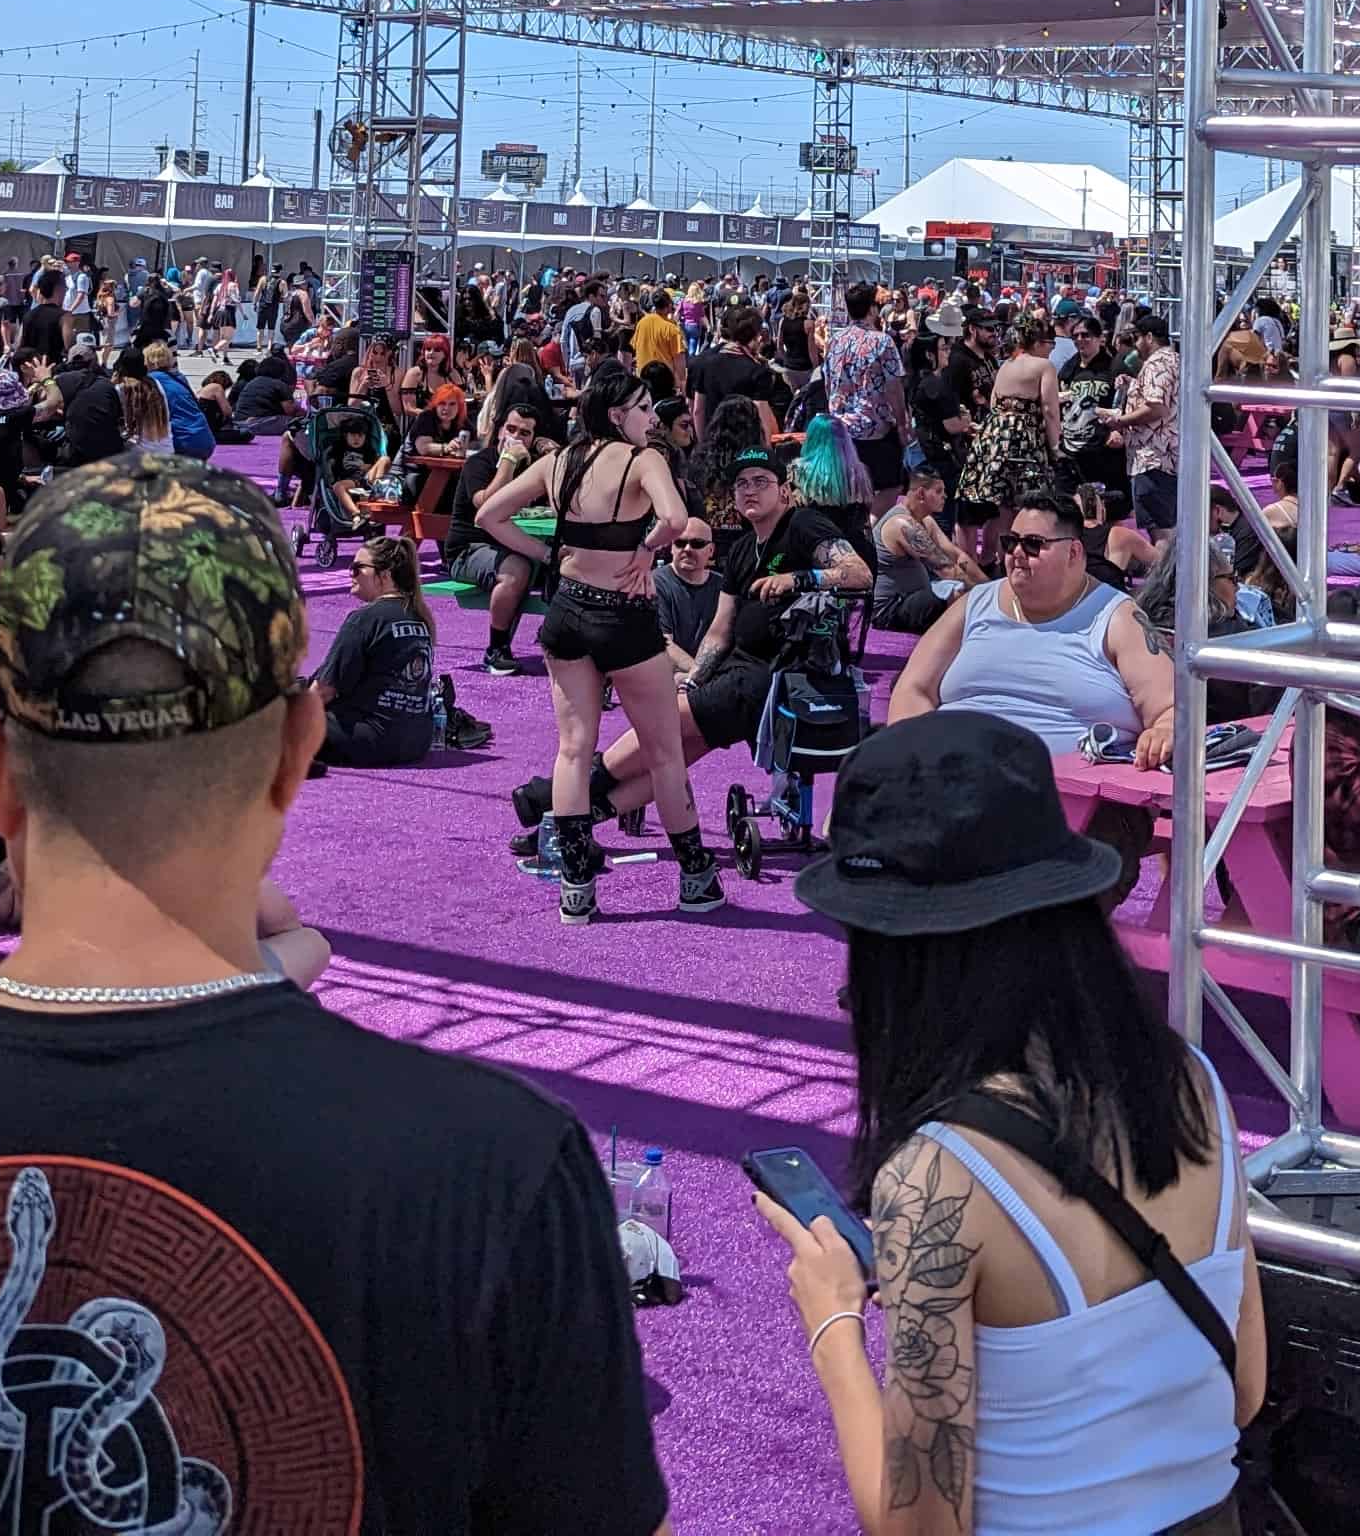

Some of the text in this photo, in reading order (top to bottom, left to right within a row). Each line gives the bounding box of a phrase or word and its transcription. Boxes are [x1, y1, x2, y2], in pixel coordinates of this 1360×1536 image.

[214, 195, 234, 210] BAR
[553, 212, 568, 225] BAR
[57, 704, 193, 735] LAS VEGAS
